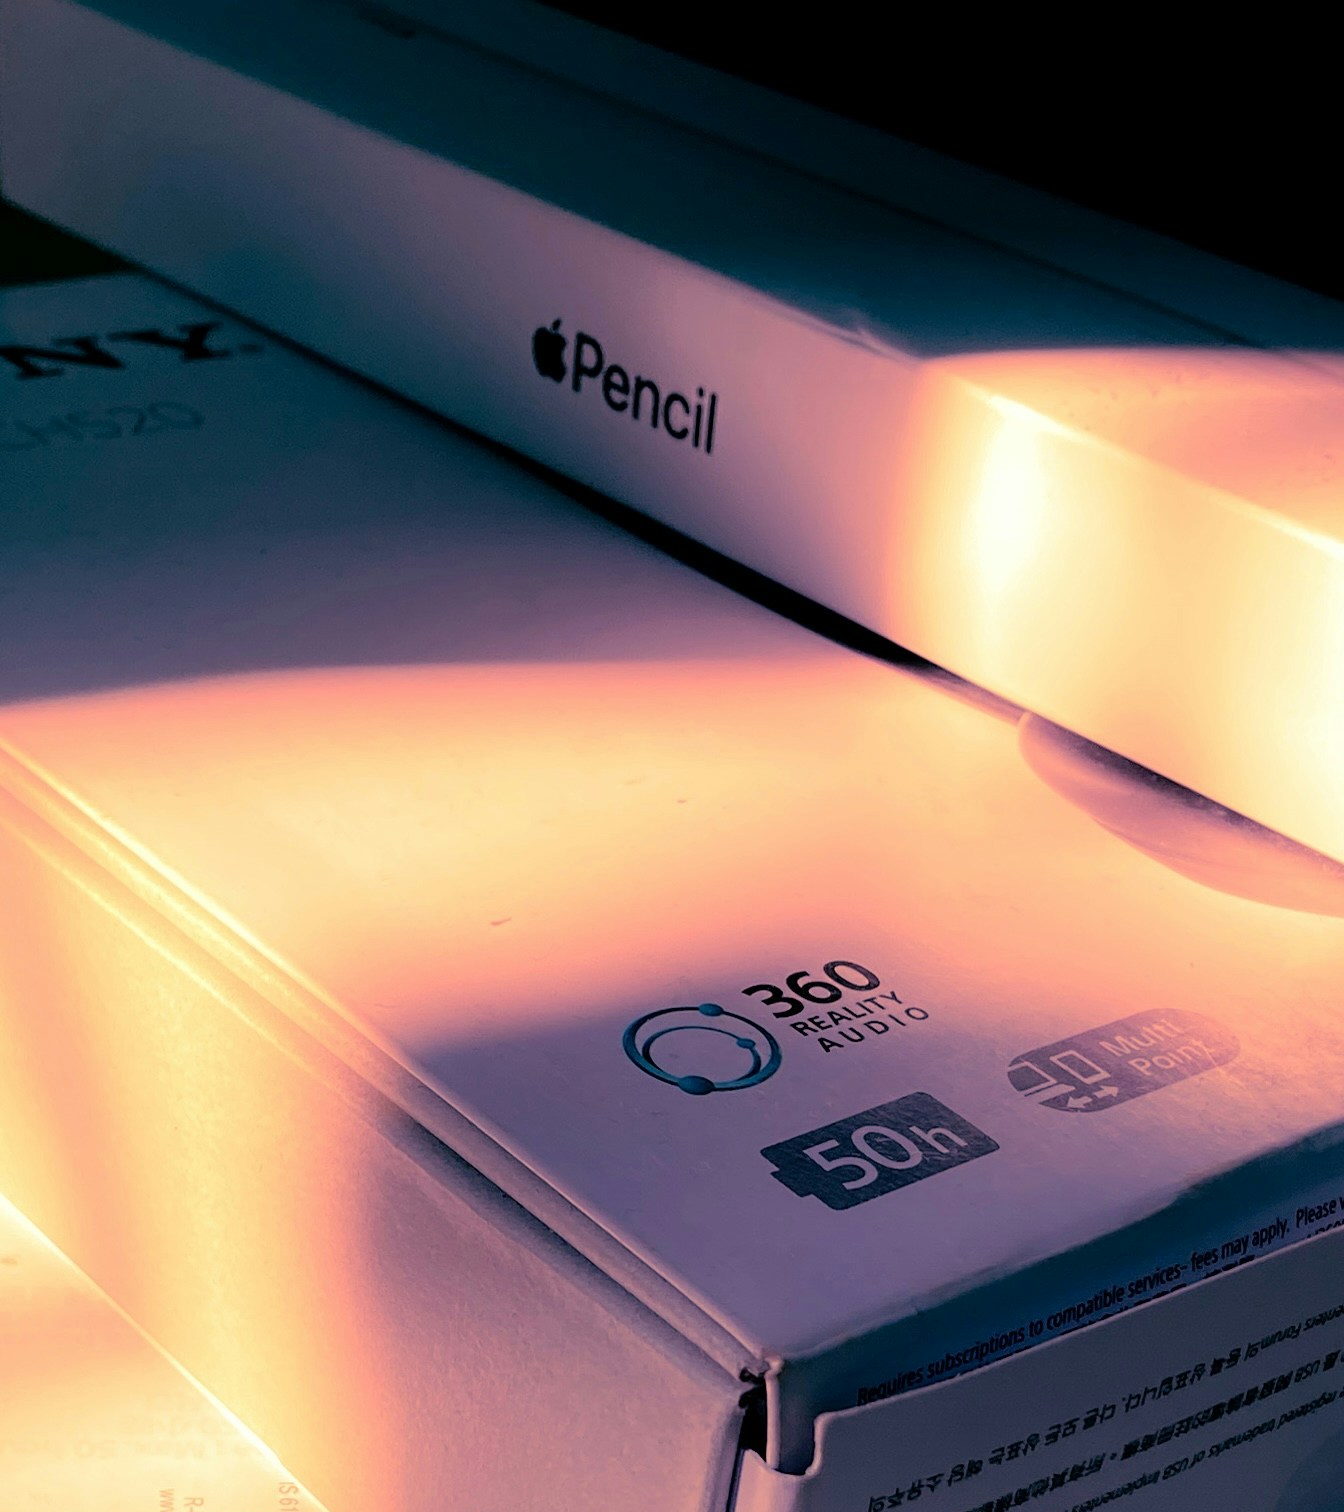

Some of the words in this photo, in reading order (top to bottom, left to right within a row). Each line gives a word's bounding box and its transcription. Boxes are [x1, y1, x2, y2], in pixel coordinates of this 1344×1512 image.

[572, 331, 717, 453] Pencil
[742, 960, 880, 1018] 360
[790, 991, 903, 1036] REALITY
[818, 1007, 929, 1052] AUDIO
[1099, 1019, 1185, 1056] Multi
[1128, 1039, 1216, 1076] Point
[803, 1126, 967, 1191] 50h
[857, 1366, 923, 1405] Requires
[927, 1328, 1025, 1379] subscriptions
[1029, 1317, 1043, 1336] to
[1047, 1285, 1125, 1331] compatible
[1191, 1252, 1219, 1272] fees
[1221, 1239, 1250, 1259] may
[1252, 1219, 1291, 1247] apply.
[1296, 1200, 1336, 1228] Please
[1121, 1364, 1204, 1412] 상표입니다.
[1295, 1358, 1321, 1382] USB
[1042, 1417, 1080, 1445] 모든
[1082, 1402, 1116, 1429] 다른
[988, 1433, 1040, 1468] 상표는
[1208, 1418, 1276, 1457] trademarks
[1162, 1457, 1189, 1479] USB
[278, 1481, 299, 1494] IS
